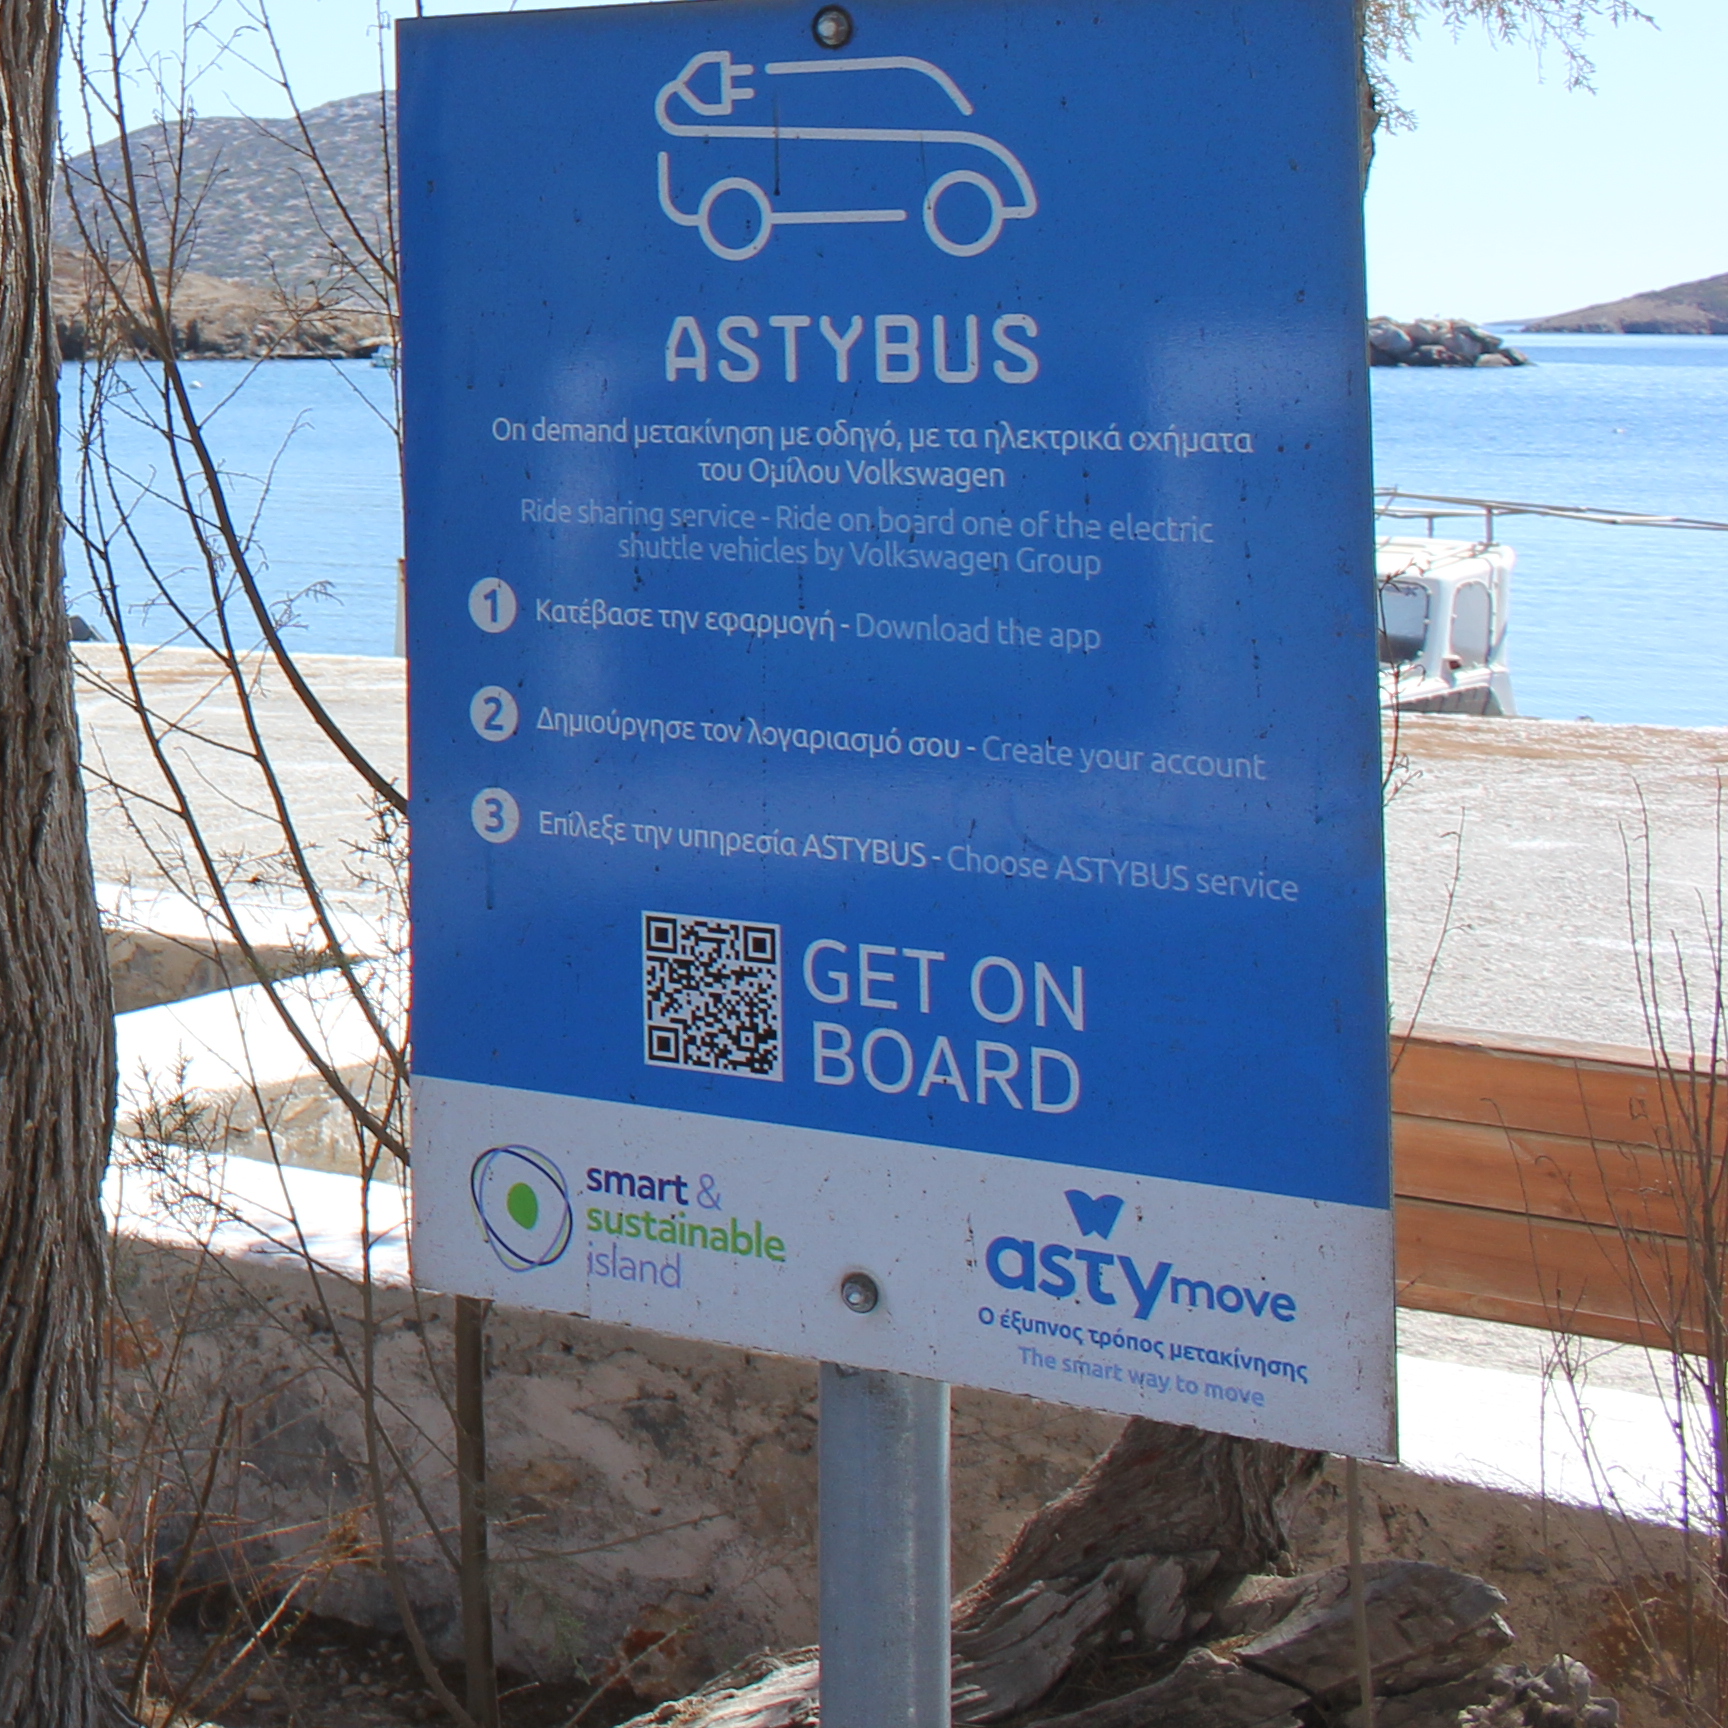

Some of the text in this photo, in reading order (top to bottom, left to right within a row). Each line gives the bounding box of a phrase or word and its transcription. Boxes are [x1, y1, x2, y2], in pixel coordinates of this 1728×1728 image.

[665, 313, 1042, 384] ASTYBUS
[492, 416, 1256, 458] On demand μετακίνηση με οδηγό, με τα ηλεκτρικά οχήματα
[697, 455, 1008, 493] του Ομίλου Volkswagen
[522, 498, 572, 524] Ride
[578, 498, 665, 531] sharing
[670, 503, 757, 530] service
[776, 503, 833, 531] Ride
[838, 513, 873, 532] on
[878, 506, 956, 535] board
[962, 515, 1014, 537] one
[1020, 509, 1051, 538] of
[1056, 511, 1103, 540] the
[1109, 512, 1215, 543] electric
[619, 530, 1102, 581] shuttle vehicles by Volkswagen Group
[483, 588, 498, 622] 1
[536, 598, 655, 630] Κατέβασε
[658, 609, 701, 635] την
[704, 609, 837, 642] εφαρμογή
[856, 612, 991, 644] Download
[998, 617, 1043, 647] the
[1049, 627, 1102, 655] app
[483, 695, 503, 731] 2
[536, 706, 697, 744] Δημιούργησε
[700, 722, 744, 744] τον
[747, 717, 904, 759] λογαριασμό
[908, 736, 963, 760] σου
[982, 735, 1074, 767] Create
[1079, 748, 1146, 774] your
[1151, 752, 1268, 781] account
[484, 797, 505, 834] 3
[539, 810, 628, 846] Επίλεξε
[631, 823, 674, 851] την
[678, 828, 799, 857] υπηρεσία
[802, 833, 929, 869] ASTYBUS
[947, 844, 1049, 880] Choose
[1055, 855, 1191, 892] ASTYBUS
[1196, 871, 1300, 902] service
[802, 938, 1085, 1032] GET ON
[813, 1021, 1083, 1115] BOARD
[586, 1167, 721, 1210] smart &
[587, 1207, 786, 1263] sustainable
[587, 1241, 681, 1289] island
[1000, 1308, 1084, 1346] έξυπνος
[1087, 1328, 1165, 1360] τρόπος
[1169, 1343, 1309, 1385] μετακίνησης
[1019, 1347, 1265, 1407] The smart way to move
